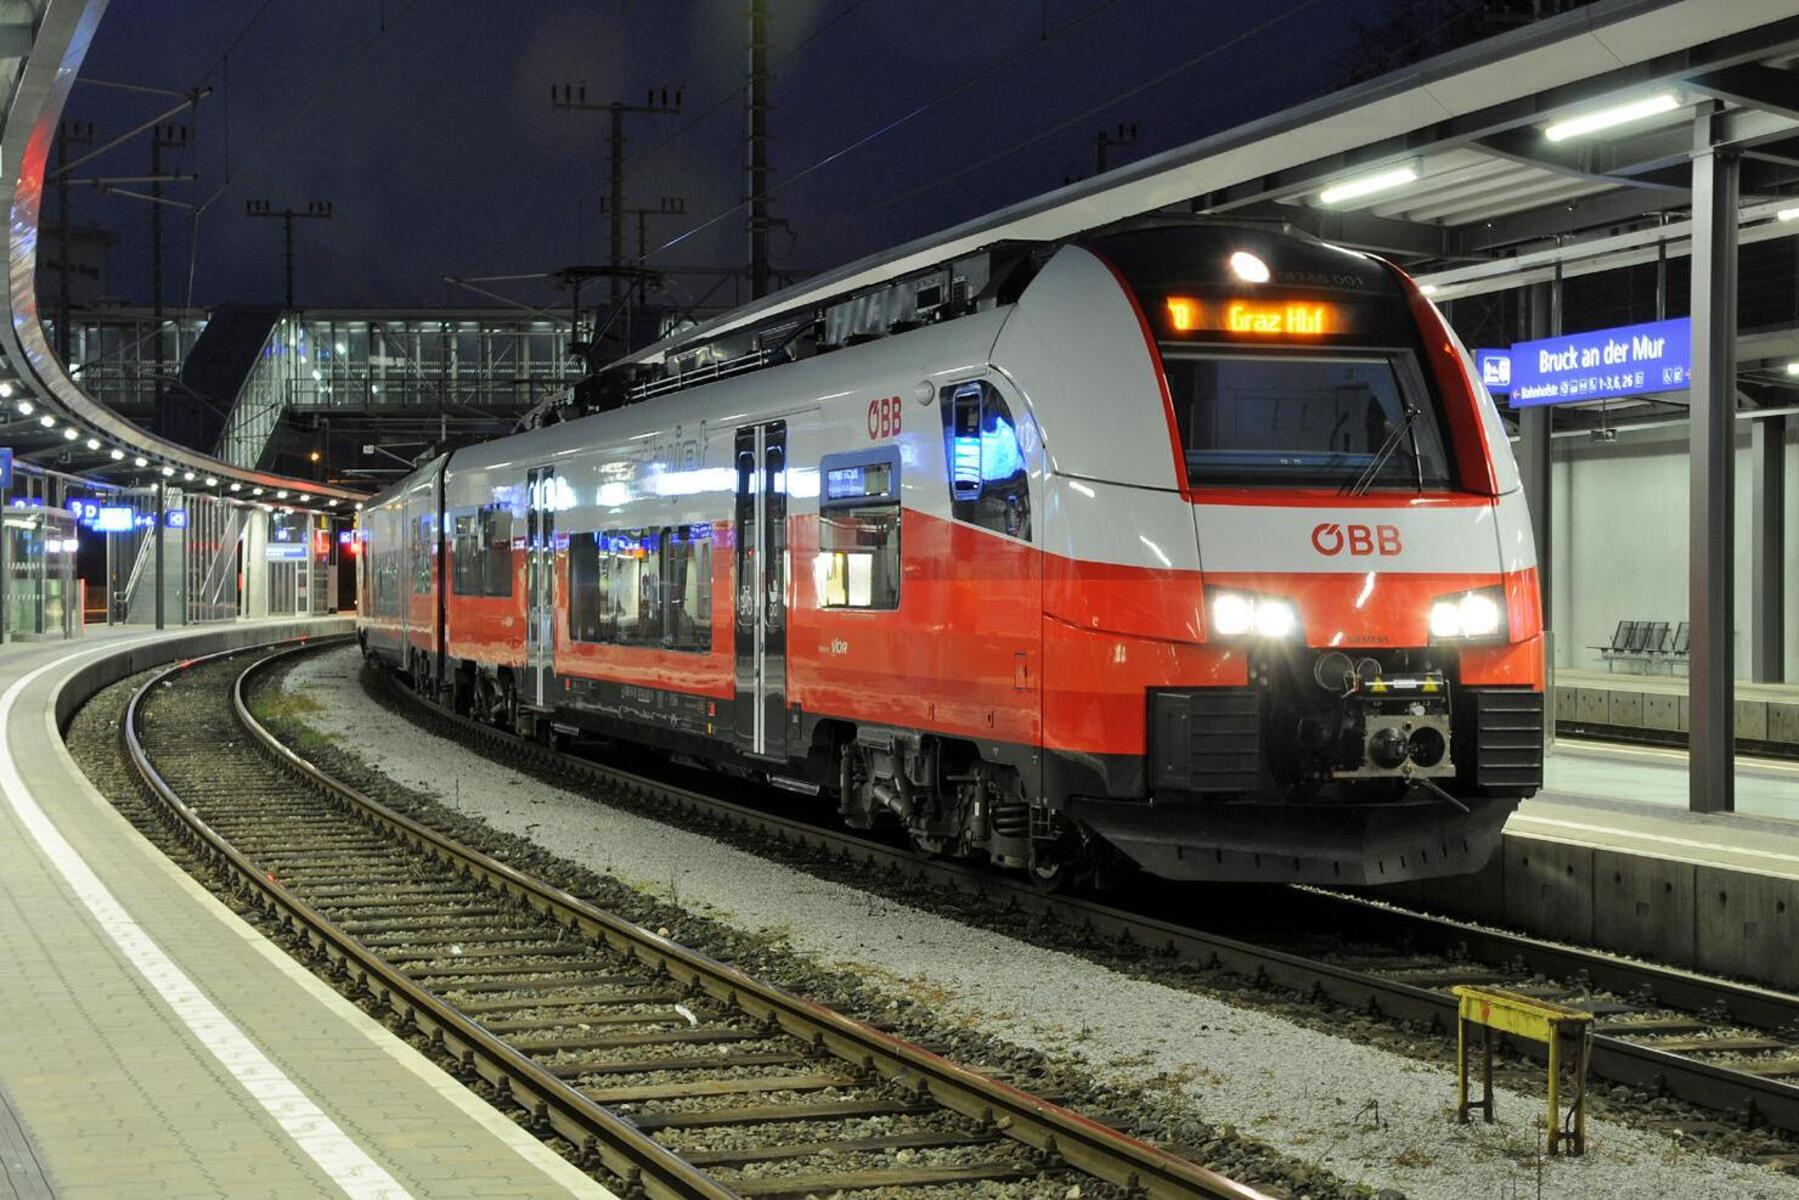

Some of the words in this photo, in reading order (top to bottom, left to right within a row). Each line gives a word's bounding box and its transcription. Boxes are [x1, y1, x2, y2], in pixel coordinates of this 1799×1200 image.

[1230, 305, 1281, 332] Graz
[1287, 307, 1323, 334] Hbf
[1540, 345, 1578, 373] Bruck
[1581, 347, 1600, 368] an
[1604, 338, 1629, 365] der
[1633, 335, 1665, 360] Mur
[868, 396, 901, 440] ÖBB
[1311, 523, 1402, 556] ÖBB
